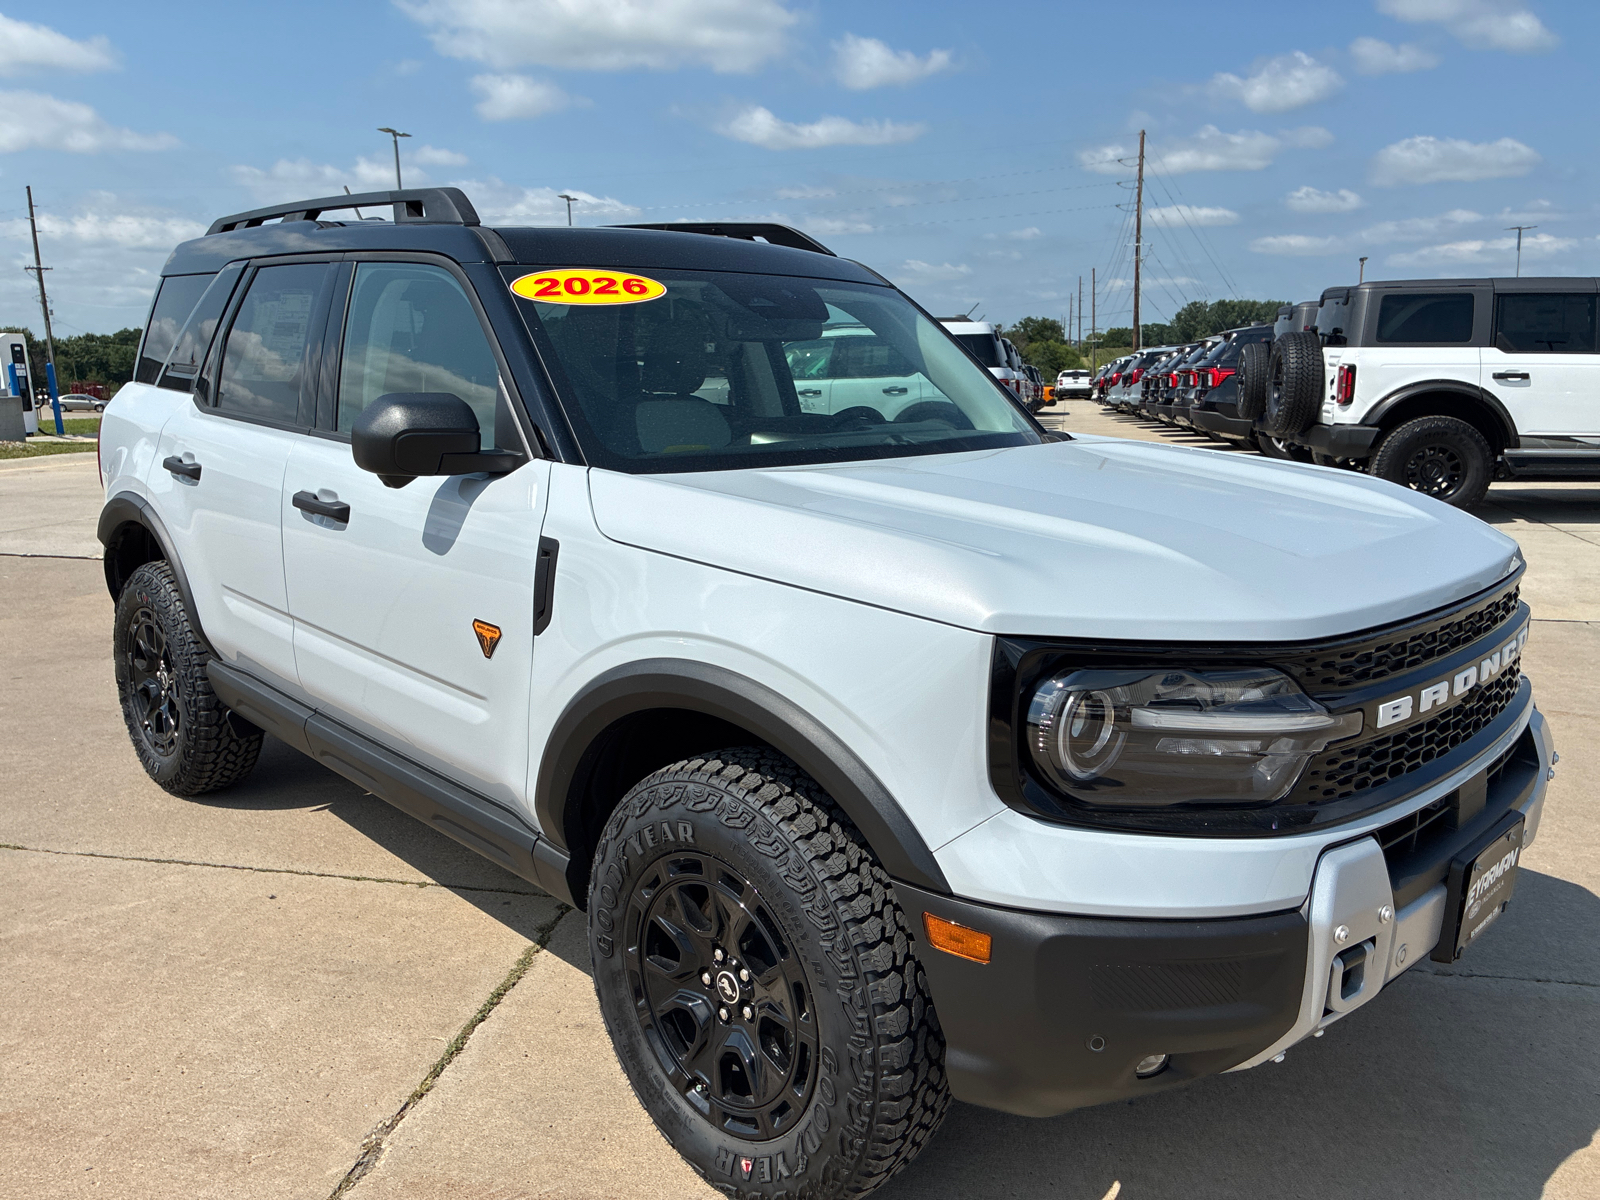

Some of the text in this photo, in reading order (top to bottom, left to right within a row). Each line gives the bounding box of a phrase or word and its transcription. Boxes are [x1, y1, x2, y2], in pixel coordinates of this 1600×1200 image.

[533, 277, 649, 297] 2026
[1377, 626, 1528, 729] BRONCO
[597, 819, 695, 958] GOODYEAR
[714, 1045, 839, 1183] GOODYEAR
